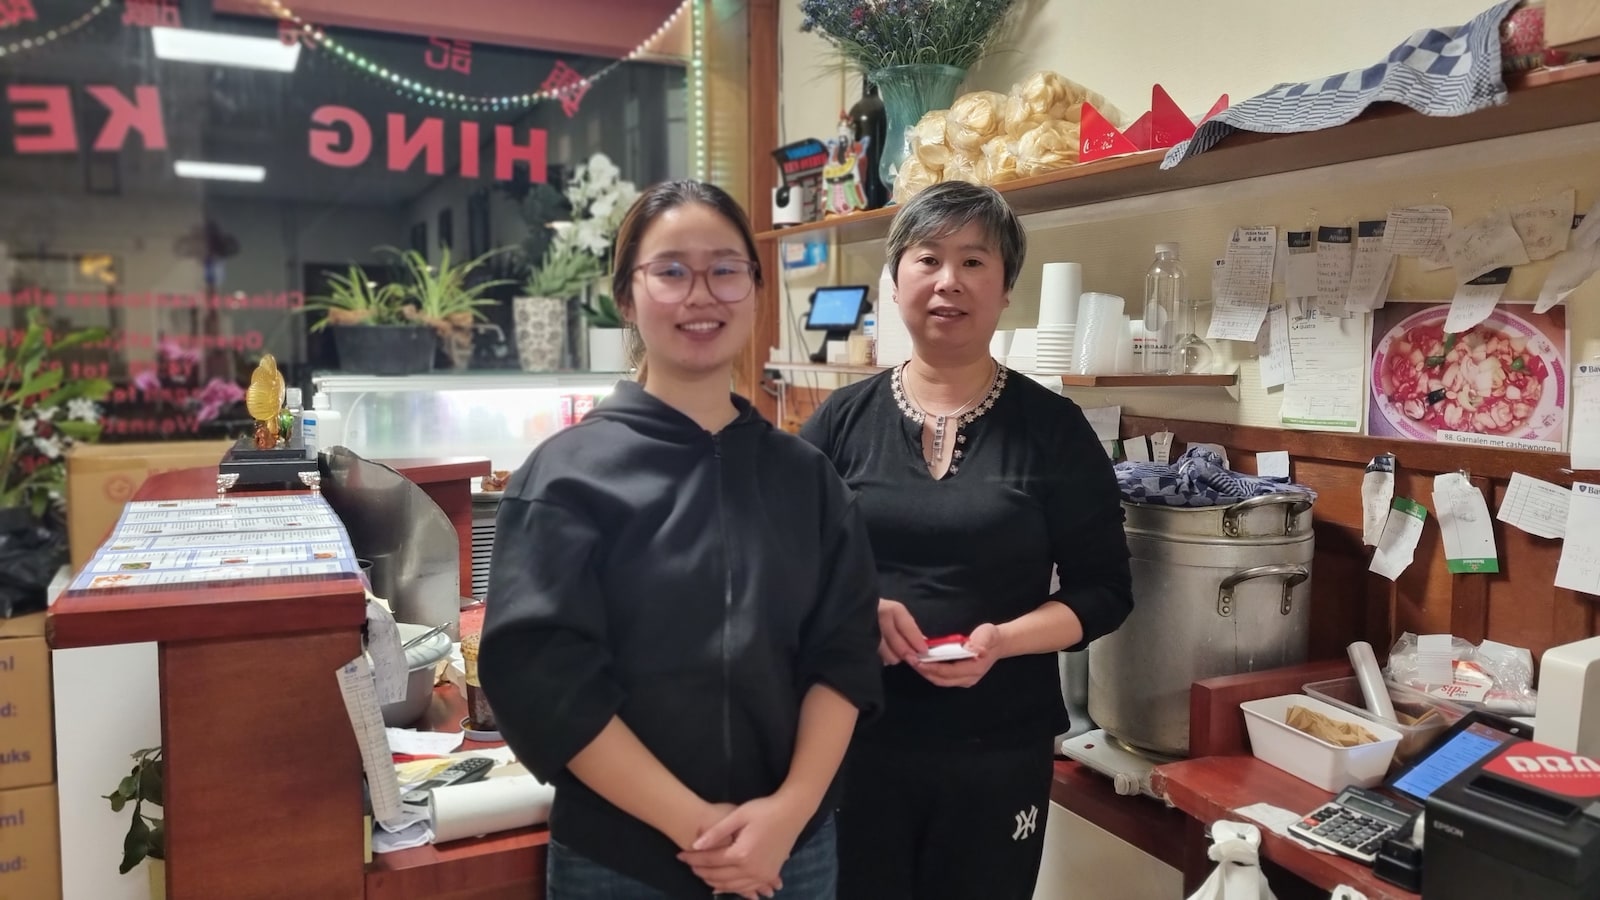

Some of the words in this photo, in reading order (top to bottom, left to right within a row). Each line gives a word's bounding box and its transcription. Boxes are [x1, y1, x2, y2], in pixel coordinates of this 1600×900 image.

[1444, 433, 1455, 441] 88.
[1456, 434, 1489, 446] Garnalen
[1489, 439, 1504, 447] met
[1012, 804, 1039, 841] NY
